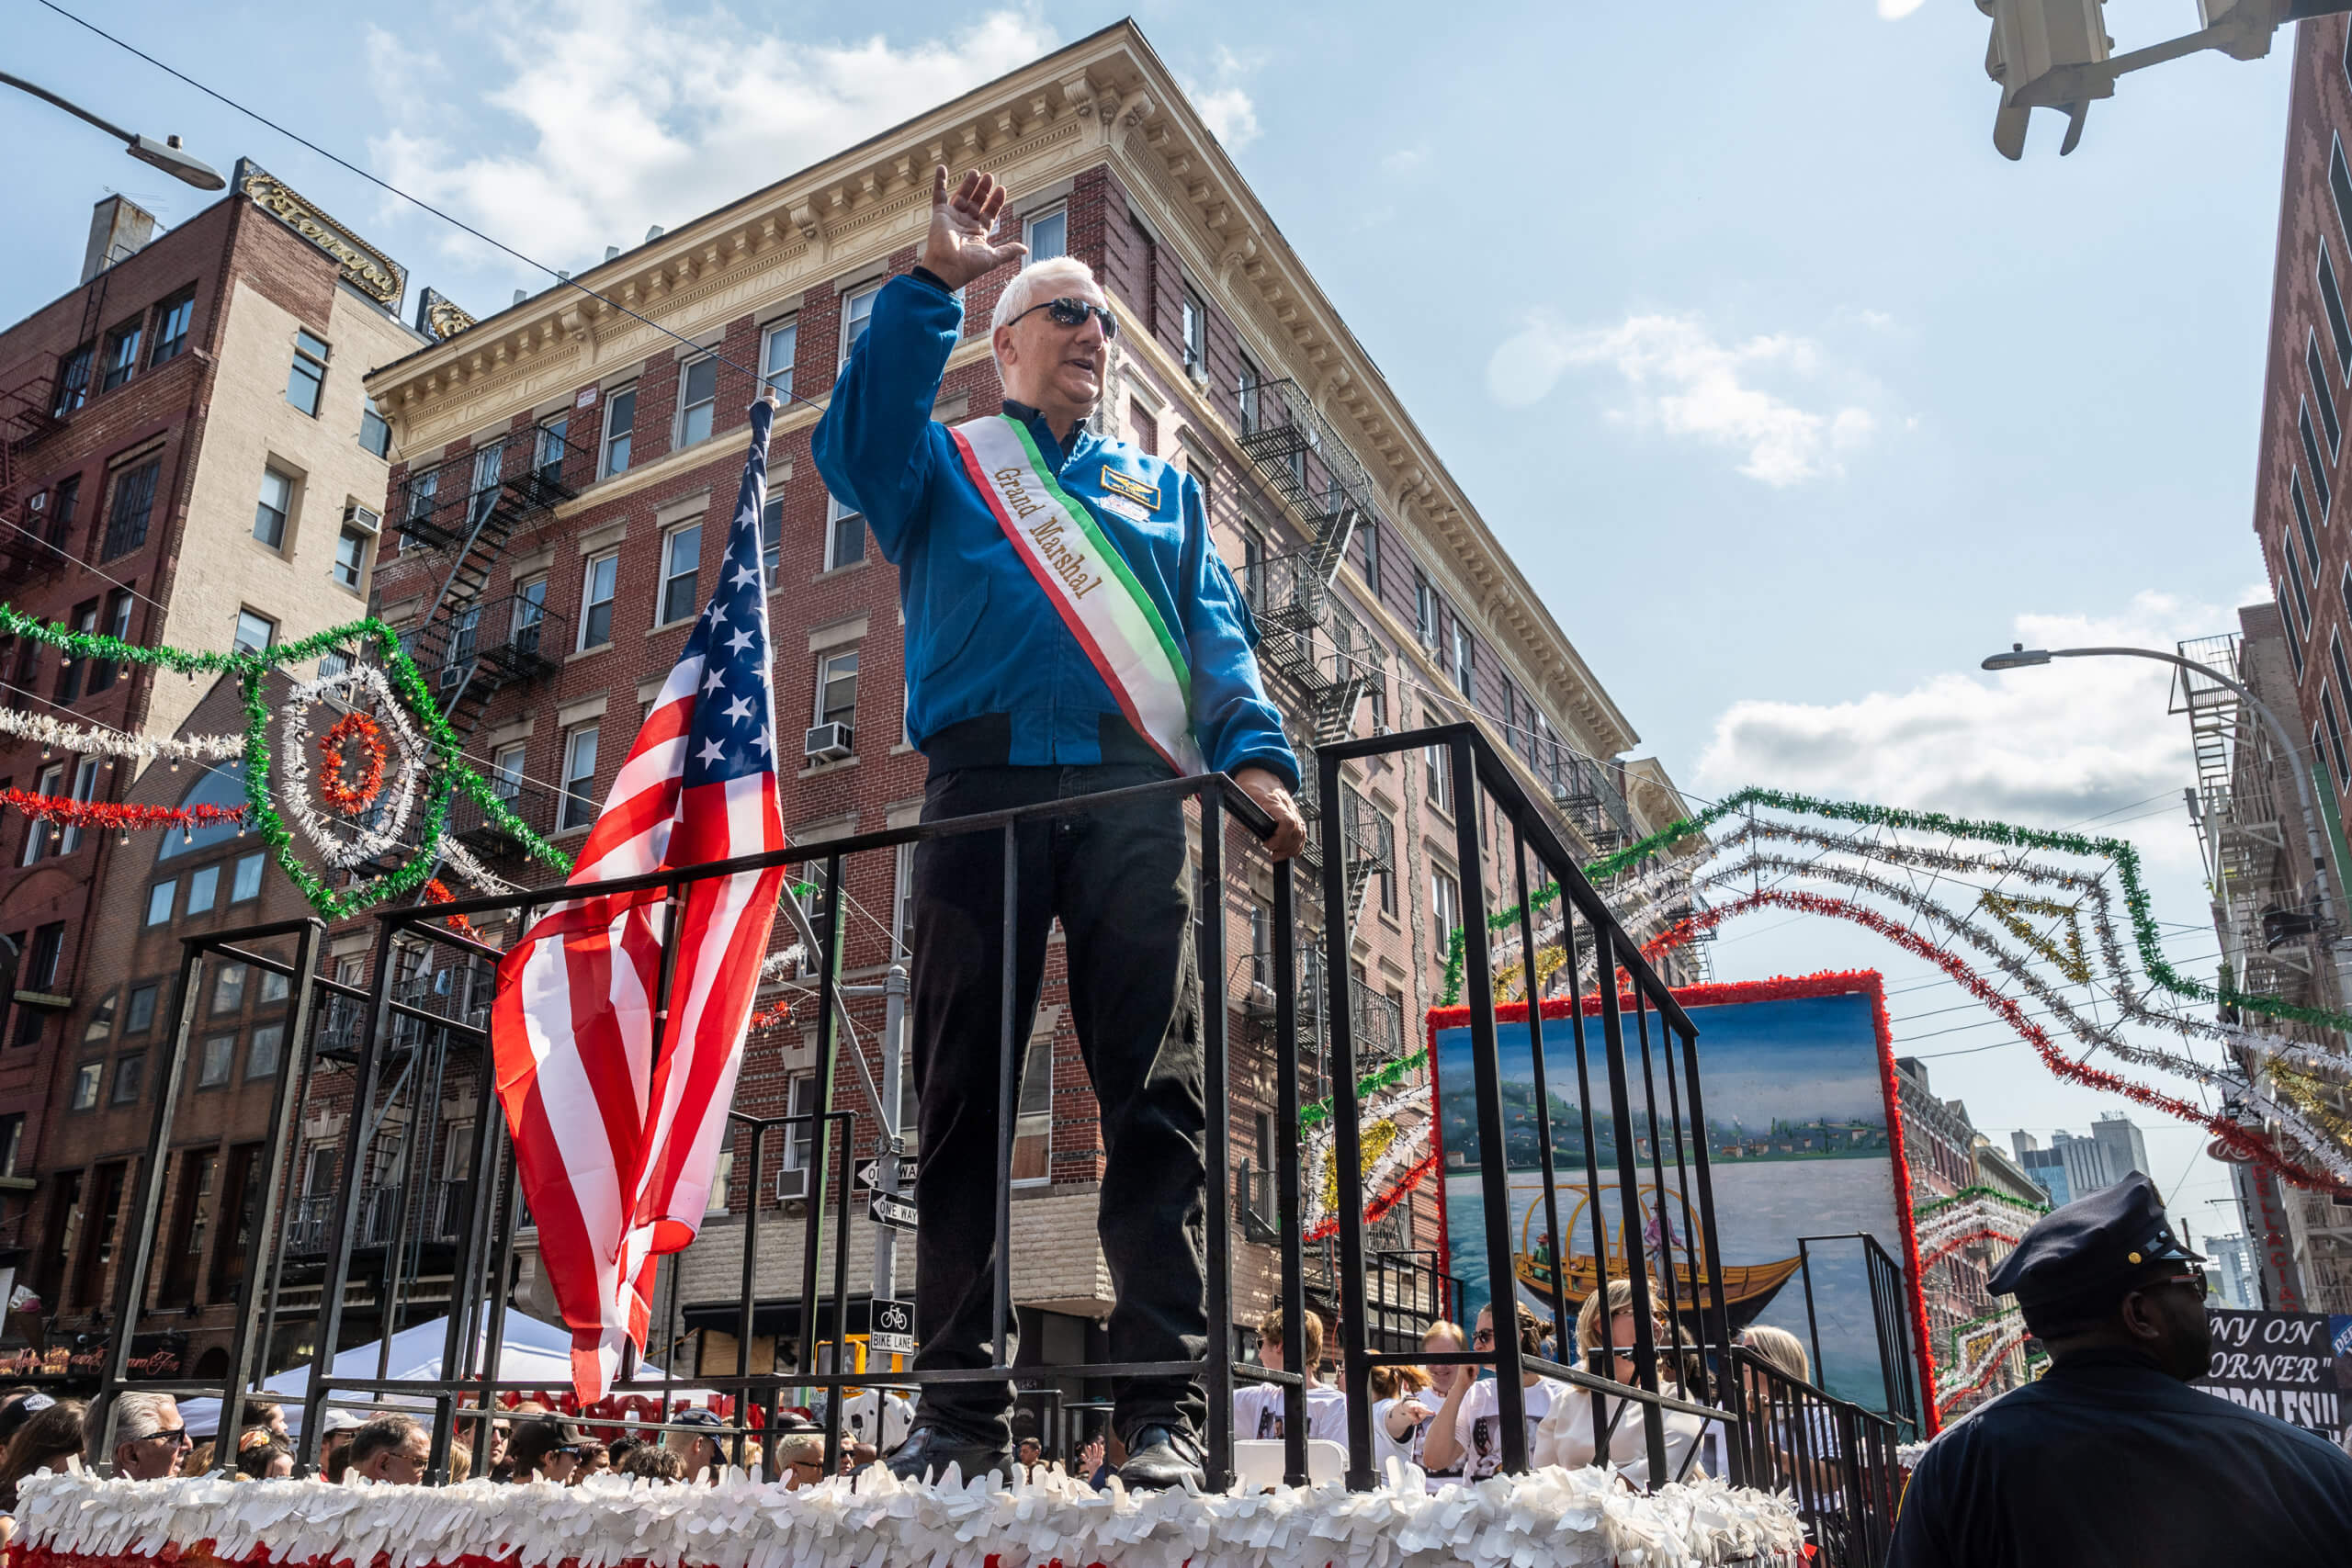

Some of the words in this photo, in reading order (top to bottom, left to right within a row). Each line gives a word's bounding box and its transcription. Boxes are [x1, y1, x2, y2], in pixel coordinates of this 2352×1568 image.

[994, 467, 1046, 520] Grand
[1029, 516, 1102, 600] Marshal
[899, 1165, 916, 1178] WA
[879, 1201, 897, 1217] ONE
[901, 1208, 917, 1224] WAY
[874, 1334, 891, 1348] BIKE
[895, 1337, 911, 1349] LANE
[2264, 1319, 2323, 1345] ON
[2208, 1352, 2333, 1383] ORNER"
